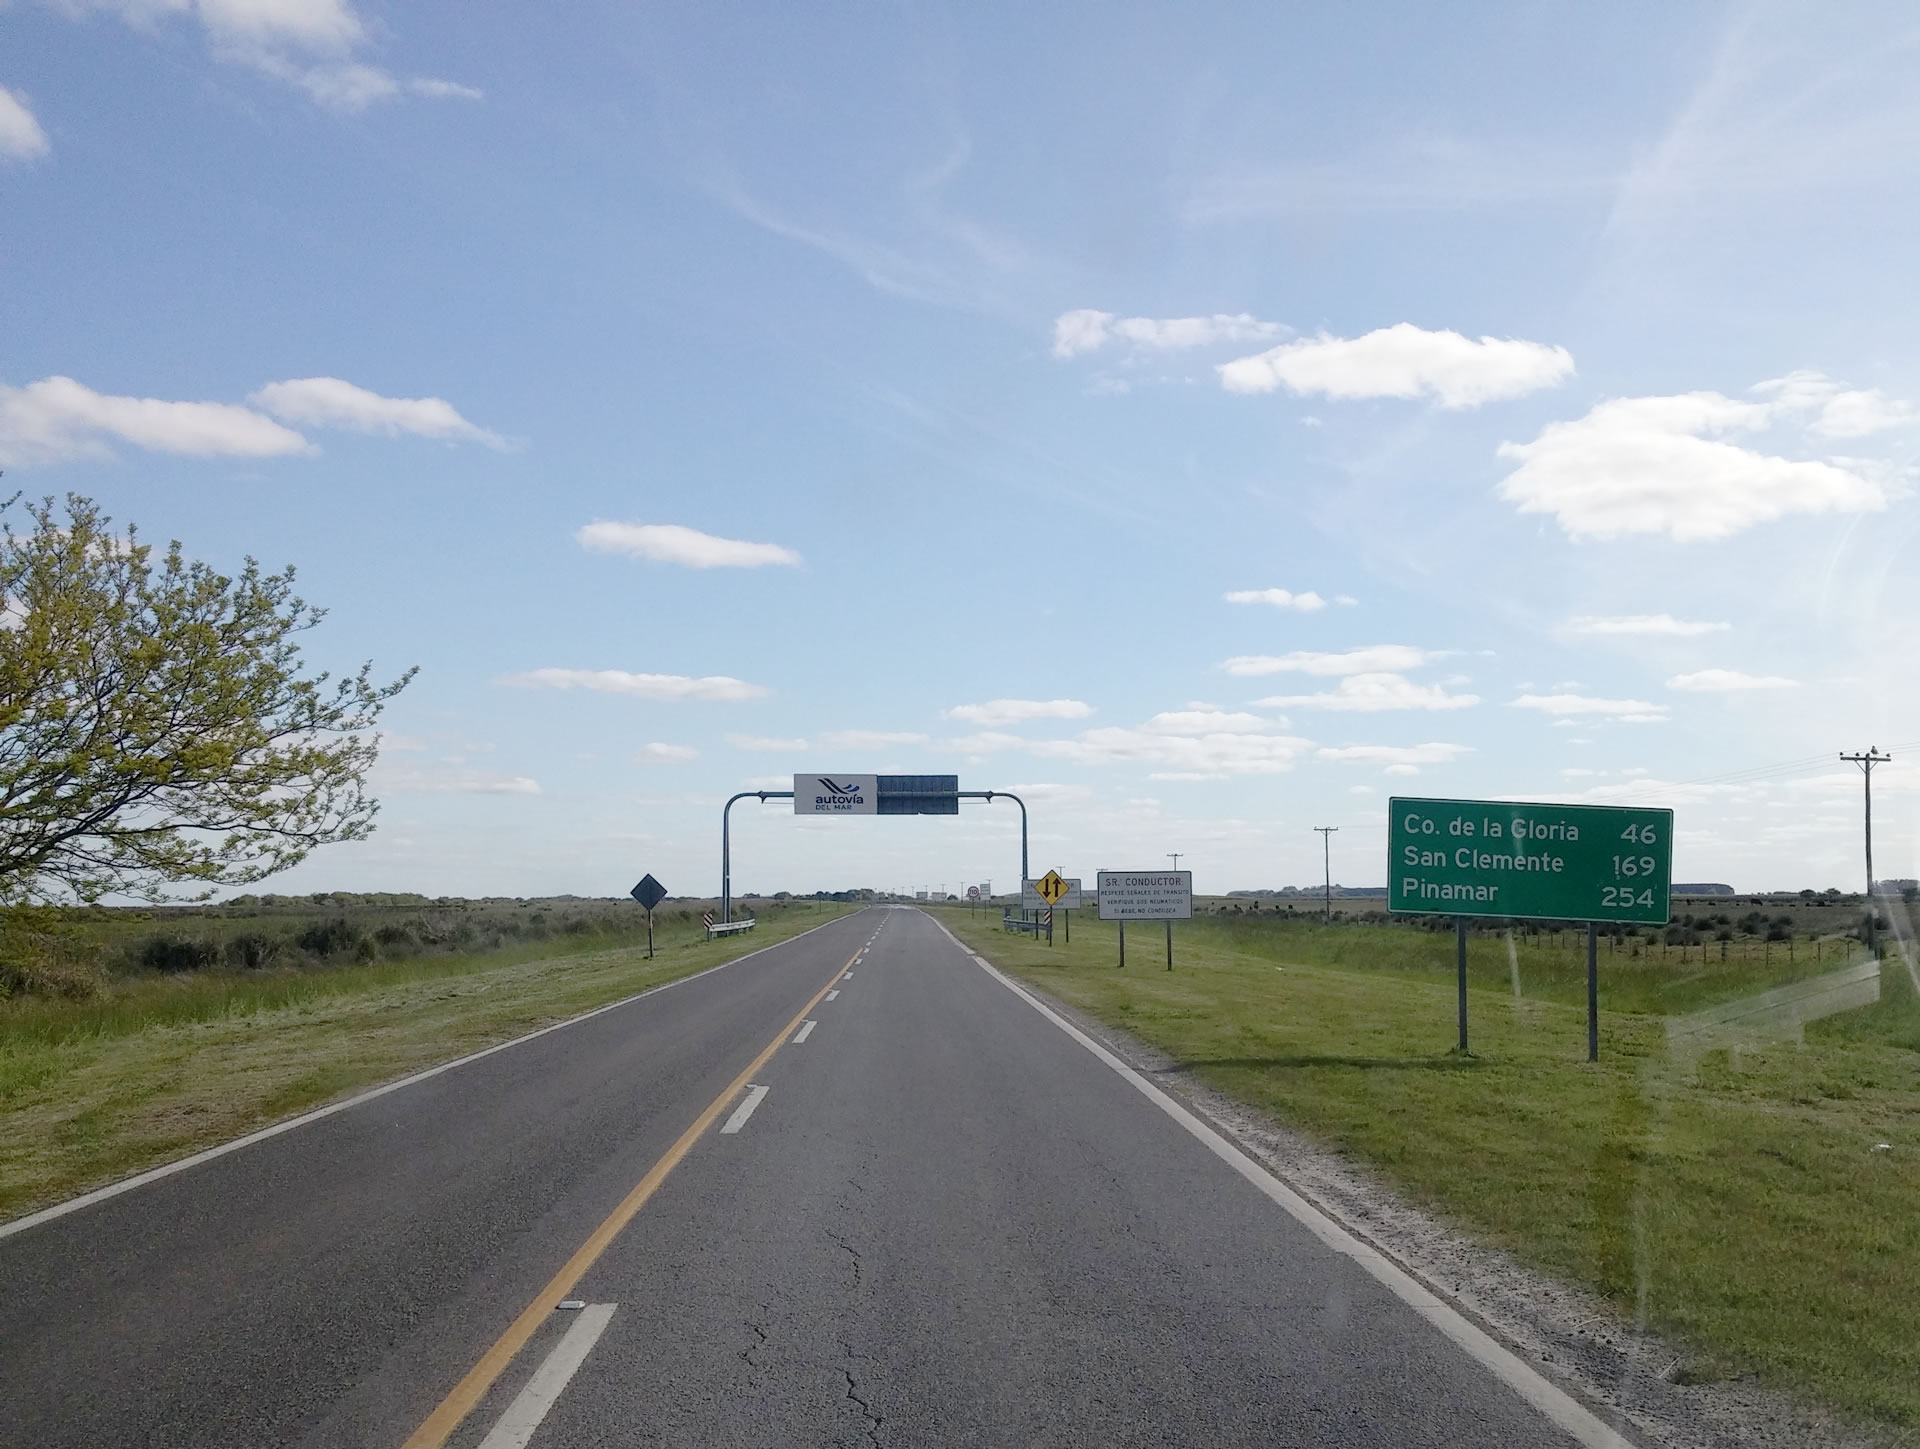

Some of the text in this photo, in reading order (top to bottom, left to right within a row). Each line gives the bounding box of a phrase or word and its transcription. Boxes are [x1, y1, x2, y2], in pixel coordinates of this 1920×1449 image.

[815, 794, 864, 804] autovía
[1404, 813, 1657, 845] Co. de la Gloria 46
[1403, 845, 1656, 877] San Clemente 169
[1106, 878, 1120, 886] SR.
[1402, 877, 1655, 909] Pinamar 254
